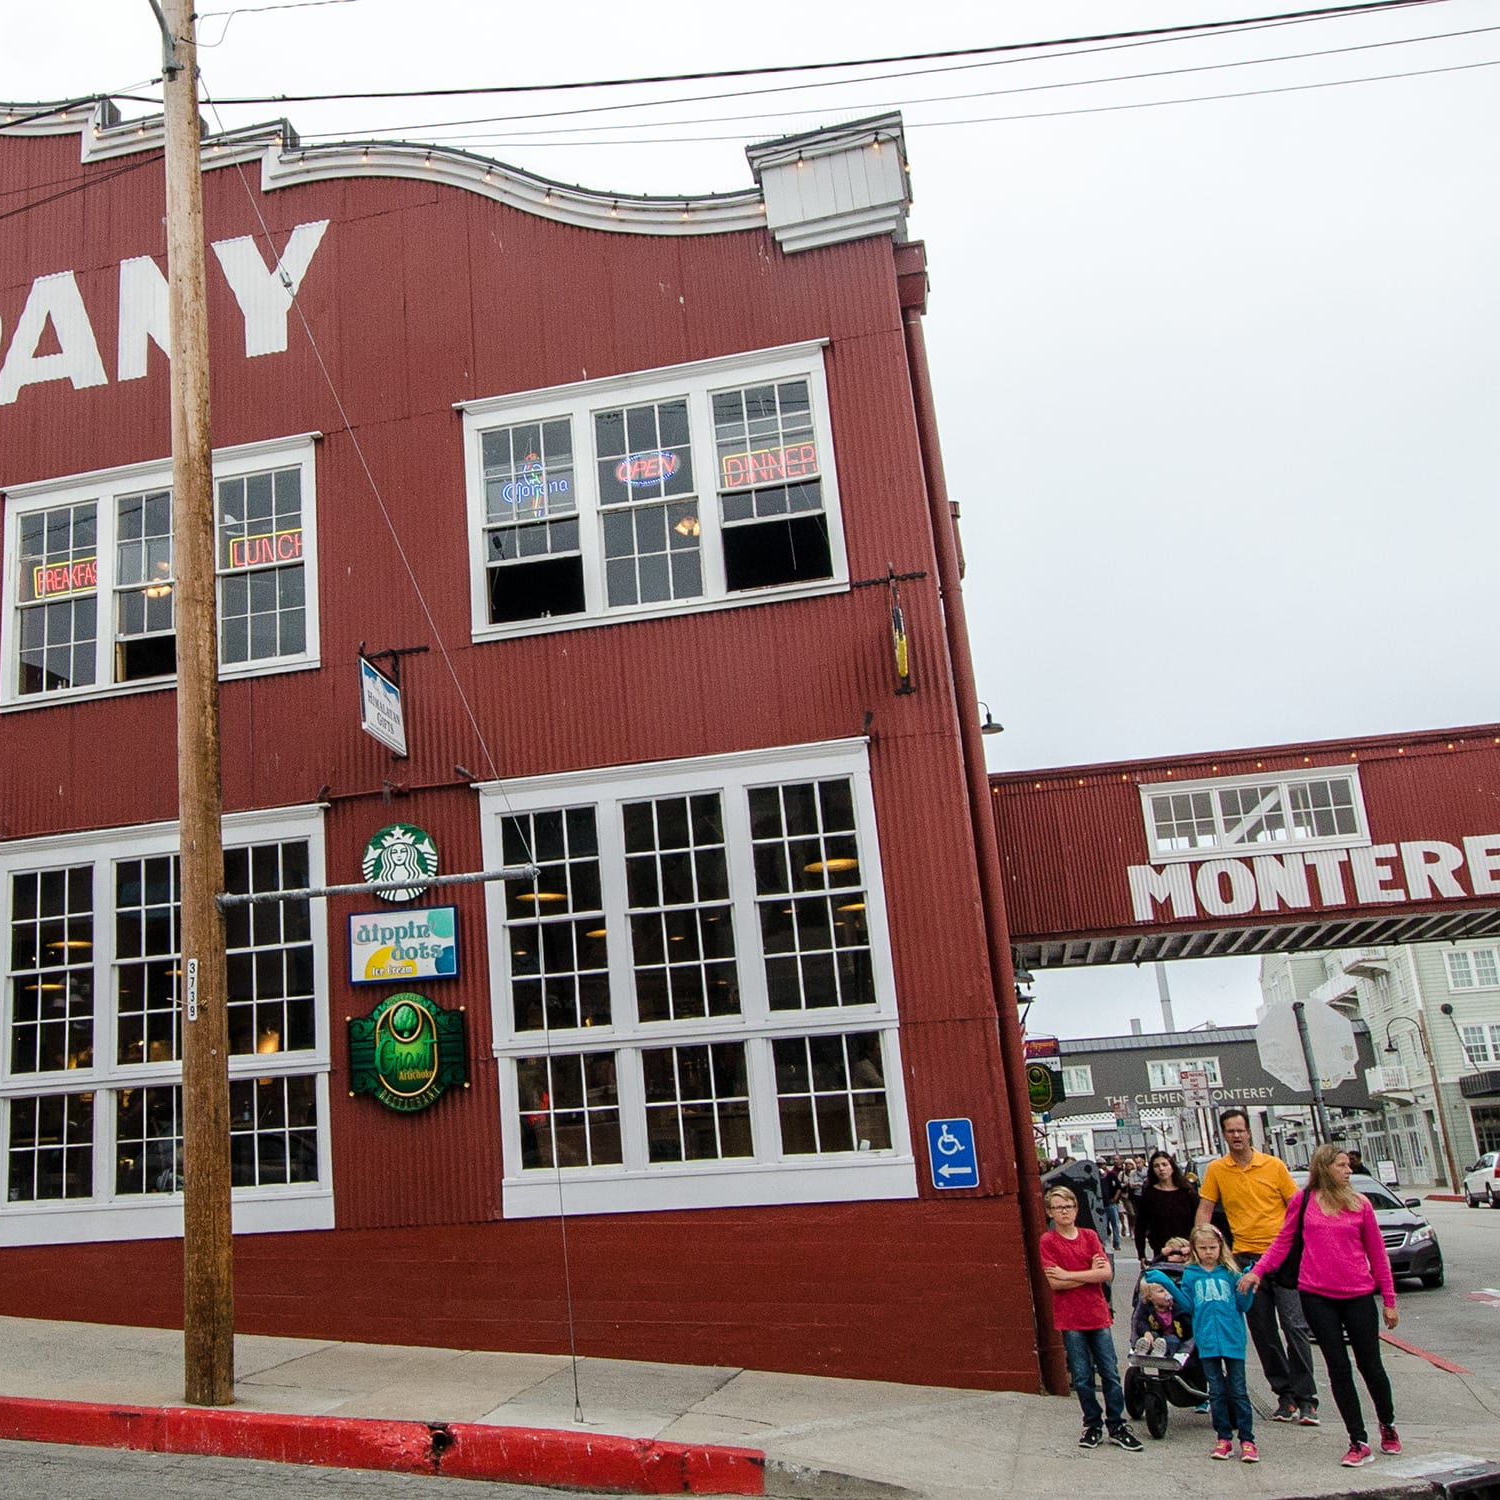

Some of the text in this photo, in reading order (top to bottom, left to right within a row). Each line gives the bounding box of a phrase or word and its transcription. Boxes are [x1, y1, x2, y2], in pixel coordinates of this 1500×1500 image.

[617, 453, 677, 483] OPEN
[726, 444, 818, 487] DINNER
[502, 479, 569, 504] Corona
[391, 940, 444, 961] dots
[188, 963, 196, 1017] 3739
[1104, 1087, 1275, 1107] THE CLEMEN ONTEREY
